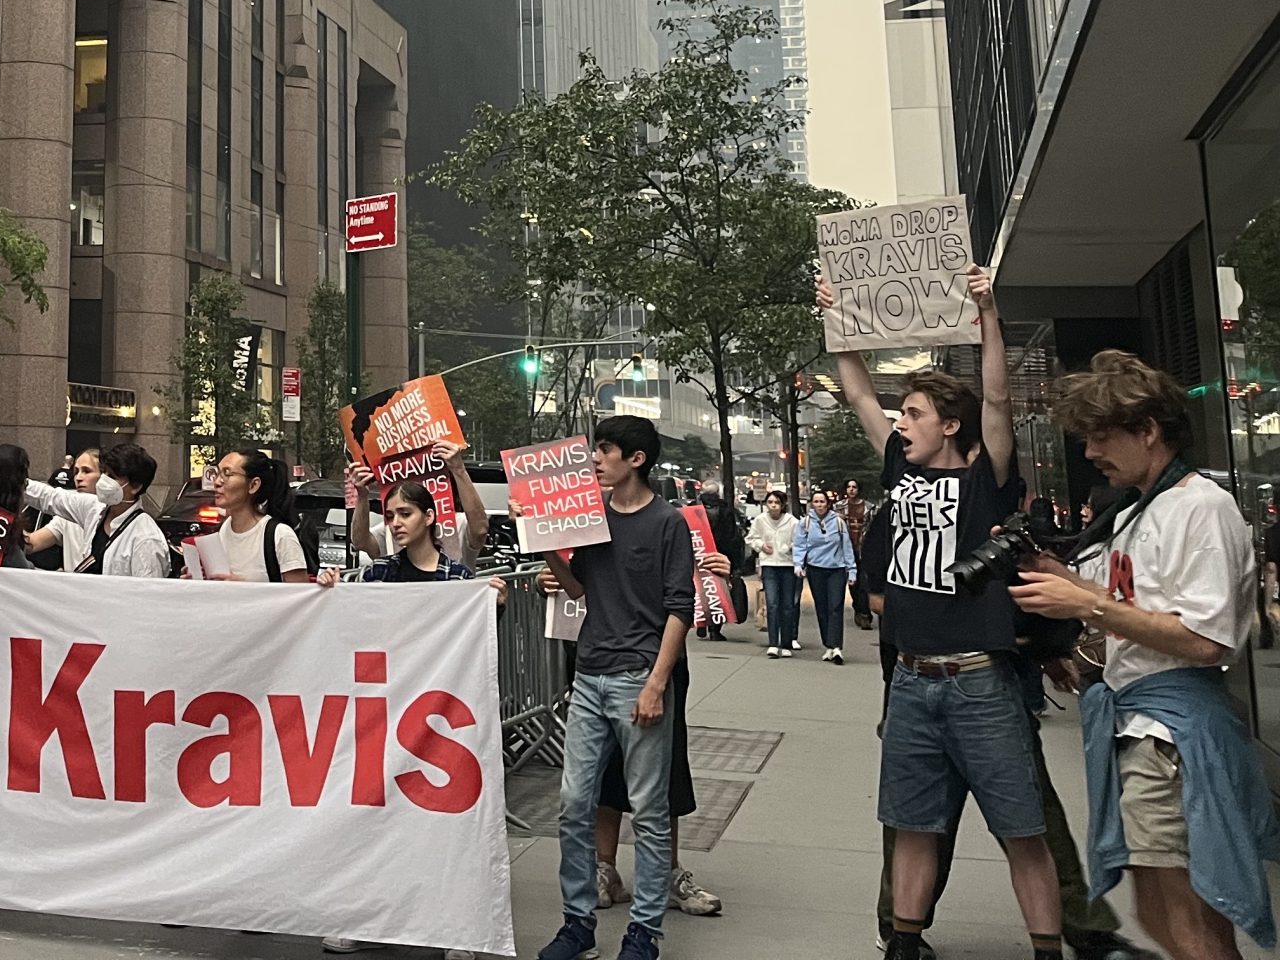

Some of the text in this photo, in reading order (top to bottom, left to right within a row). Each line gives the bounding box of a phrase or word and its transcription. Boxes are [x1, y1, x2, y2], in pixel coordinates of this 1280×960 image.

[349, 200, 389, 216] NO STANDING
[349, 215, 375, 228] Anytime
[891, 205, 959, 238] DROP
[825, 233, 968, 284] KRAVIS
[840, 274, 970, 337] NOW
[374, 389, 426, 434] NO MORE
[376, 406, 432, 454] BUSINESS
[412, 419, 452, 450] USUAL
[377, 452, 445, 485] KRAVIS
[508, 443, 588, 477] KRAVIS
[528, 468, 594, 498] FUNDS
[522, 489, 599, 520] CLIMATE
[536, 510, 604, 535] CHAOS
[891, 528, 954, 592] KILL
[701, 576, 726, 625] KRAVIS
[7, 636, 484, 815] Kravis
